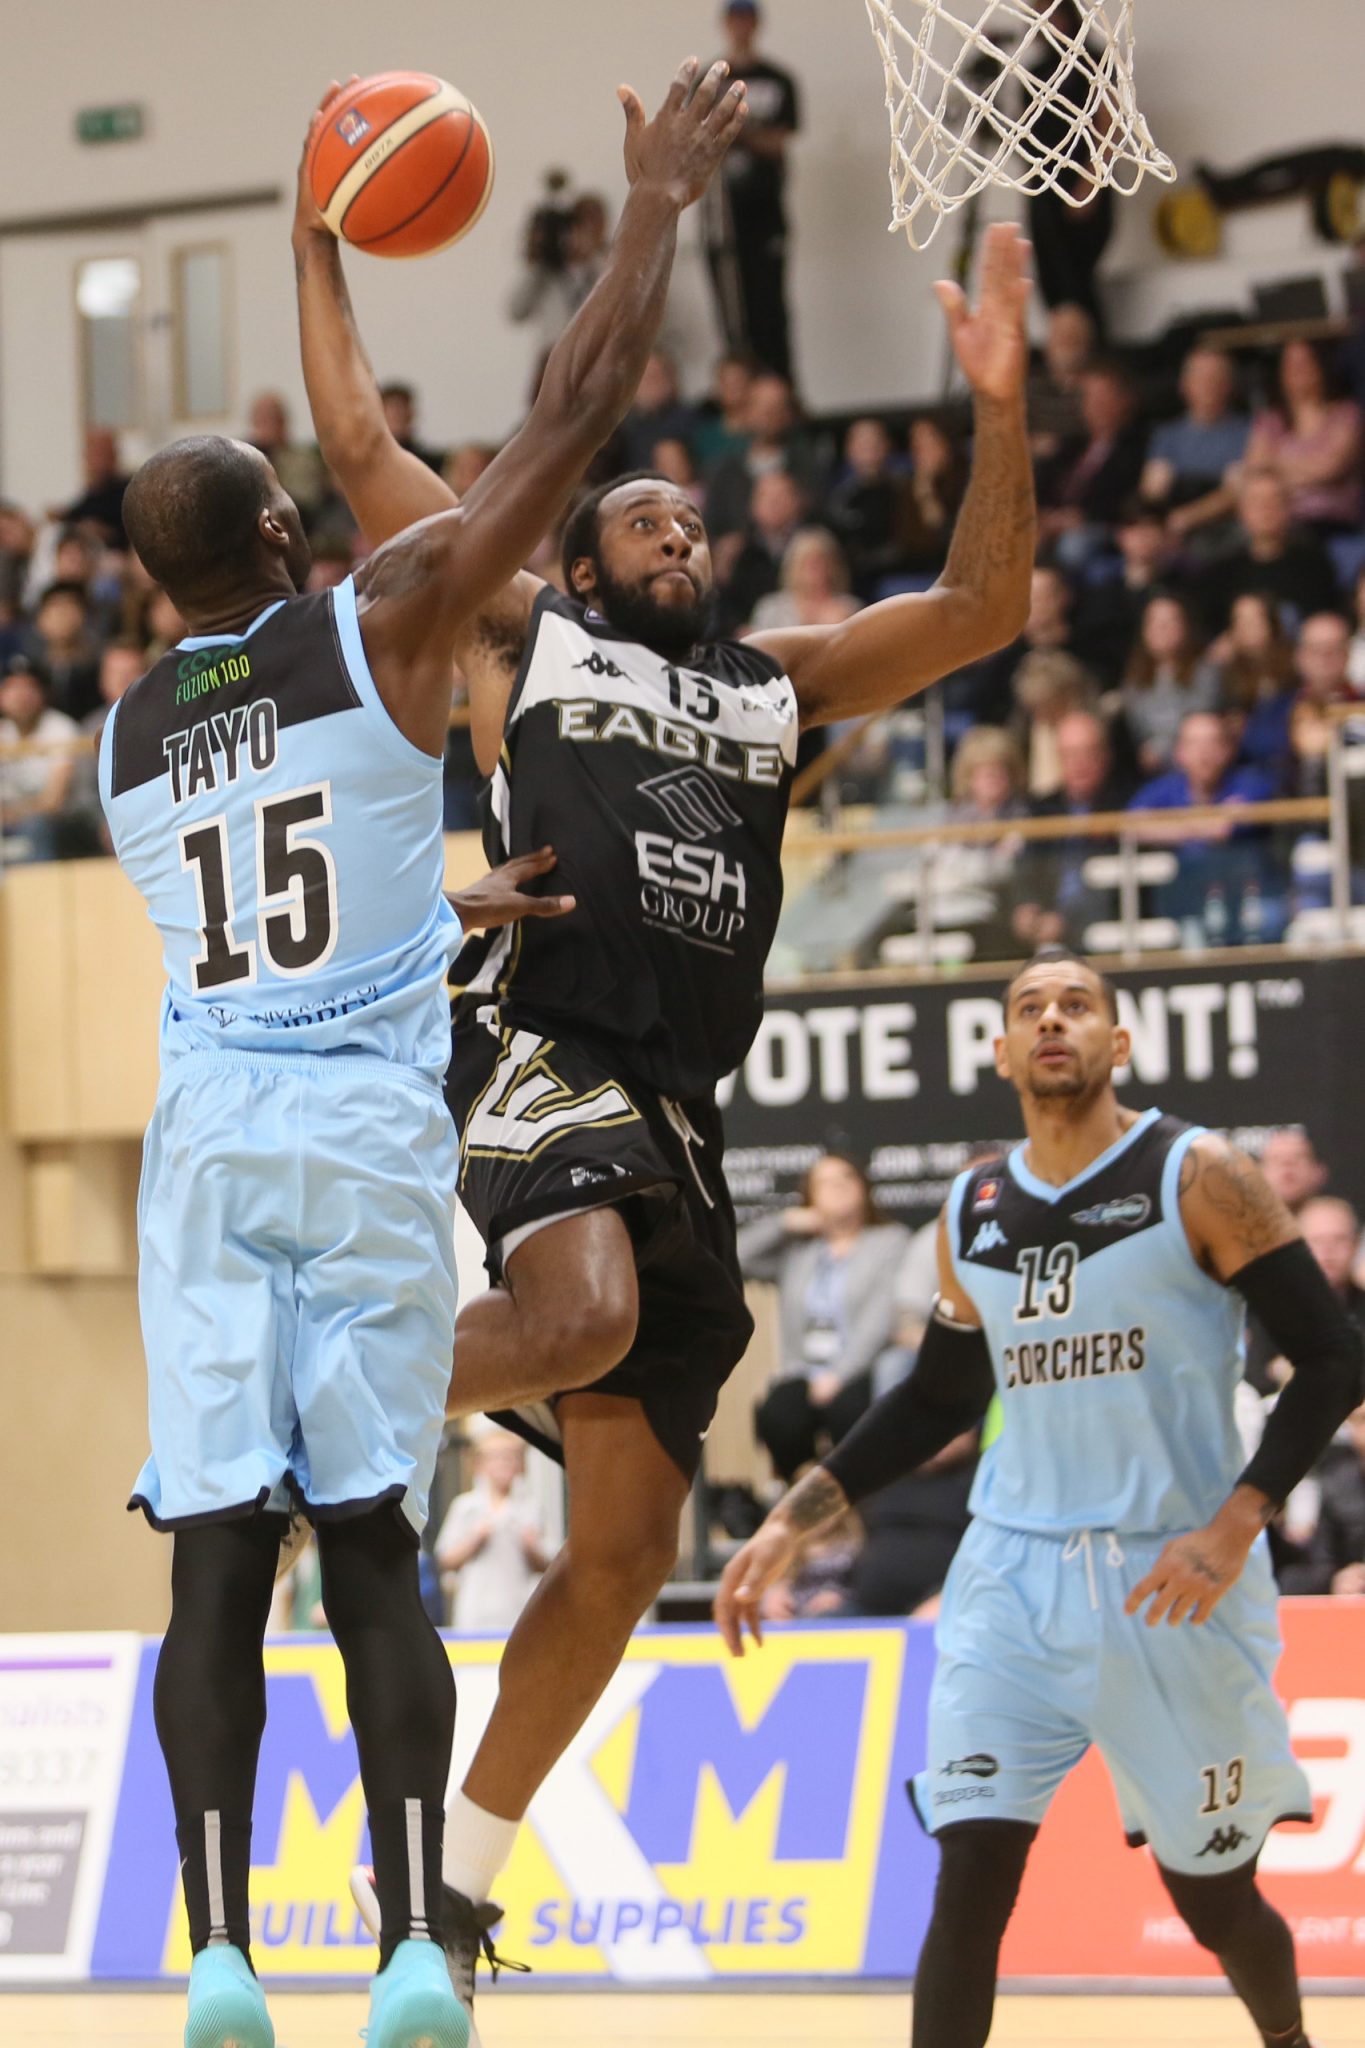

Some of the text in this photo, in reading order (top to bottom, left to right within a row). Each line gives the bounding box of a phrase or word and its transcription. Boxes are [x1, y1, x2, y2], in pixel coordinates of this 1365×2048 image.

[176, 654, 250, 706] FUZION 100
[661, 664, 720, 723] 13
[163, 697, 278, 804] TAYO
[553, 699, 785, 787] EAGLE
[178, 779, 338, 994] 15
[635, 831, 746, 909] ESH
[640, 882, 745, 942] GROUP
[714, 1003, 920, 1107] OTE
[946, 980, 1258, 1096] PNT!
[1014, 1241, 1080, 1325] 13
[1198, 1755, 1246, 1815] 13
[530, 1899, 807, 1946] SUPPLIES
